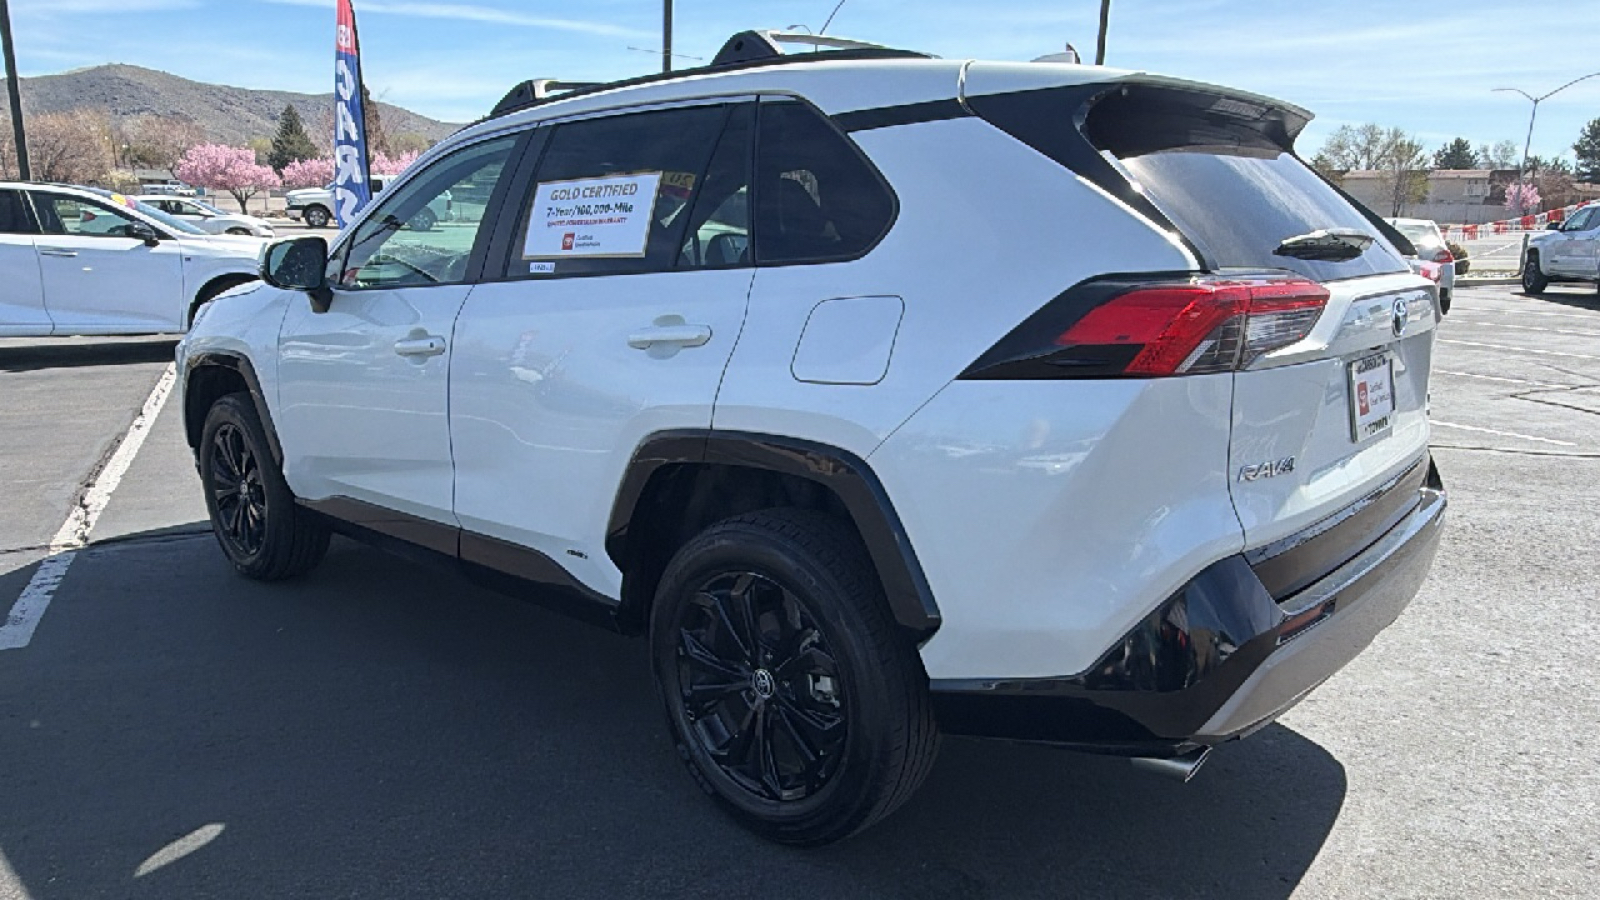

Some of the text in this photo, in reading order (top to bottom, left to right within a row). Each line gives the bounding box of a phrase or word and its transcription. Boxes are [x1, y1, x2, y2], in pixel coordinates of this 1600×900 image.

[550, 183, 639, 201] GOLD CERTIFIED
[546, 203, 634, 218] 7-Year/100,000-Mile
[1238, 455, 1296, 483] RAV4
